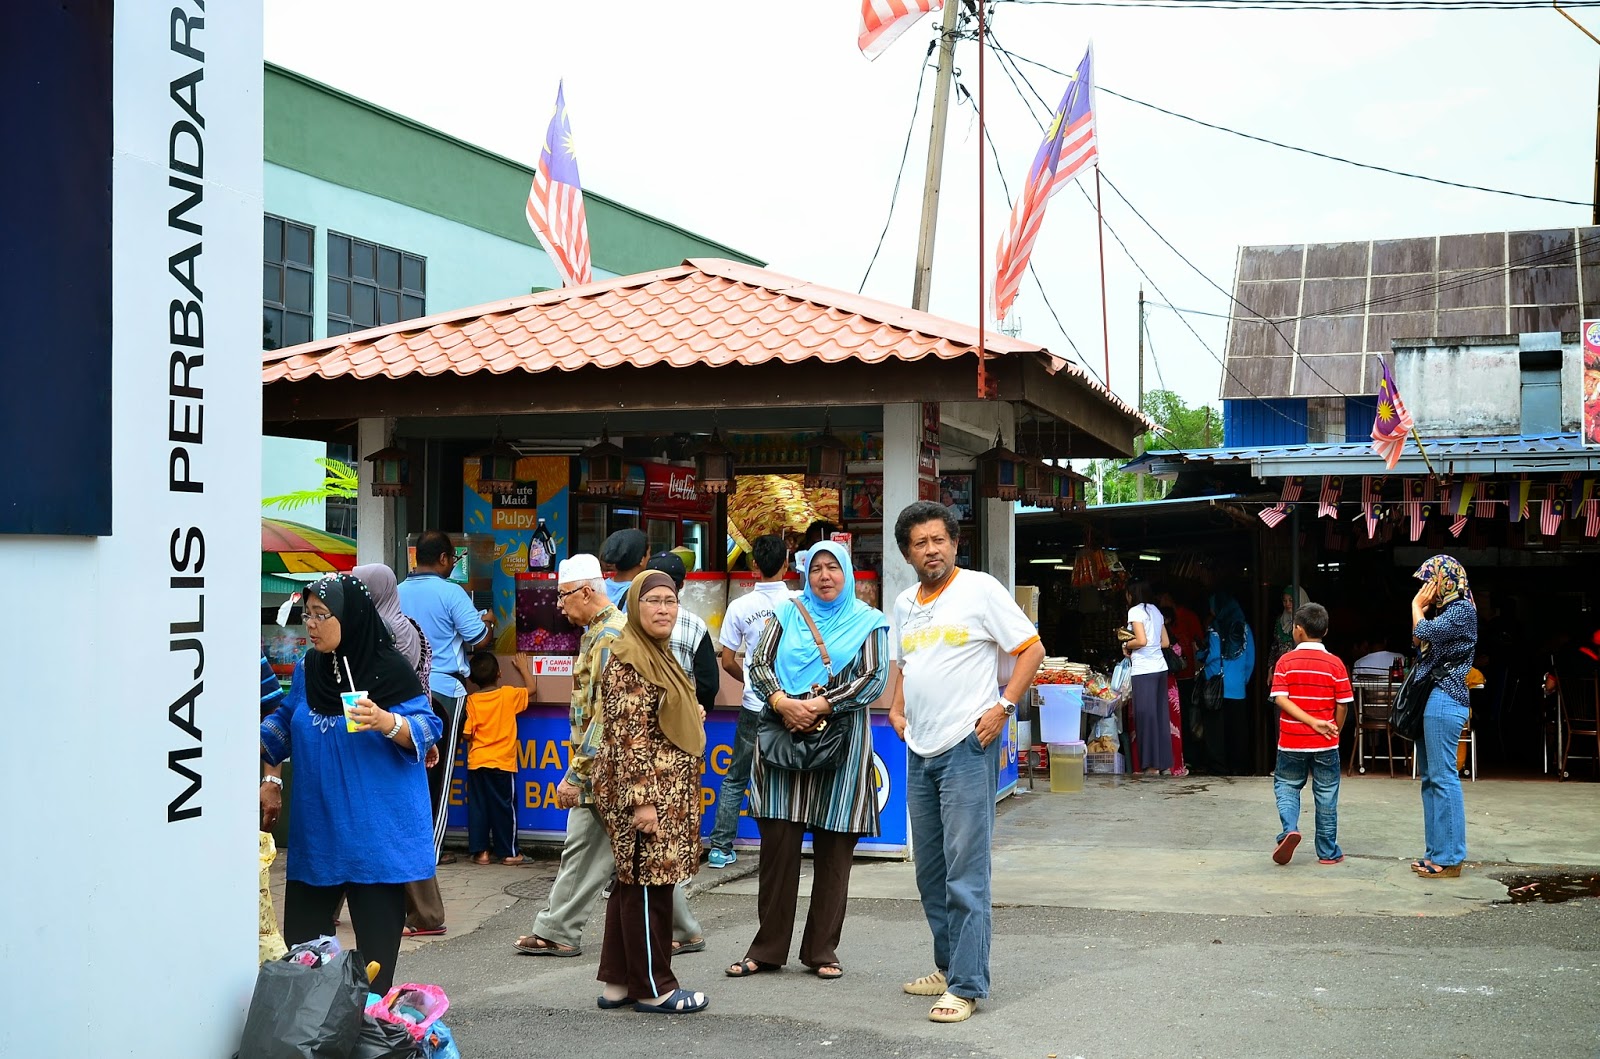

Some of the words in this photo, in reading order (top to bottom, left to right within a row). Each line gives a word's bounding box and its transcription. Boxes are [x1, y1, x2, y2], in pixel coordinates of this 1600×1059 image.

[168, 0, 205, 494] PERBANDAR
[496, 511, 534, 528] Pulpy
[501, 494, 528, 505] Maid
[167, 526, 205, 823] MAJLIS
